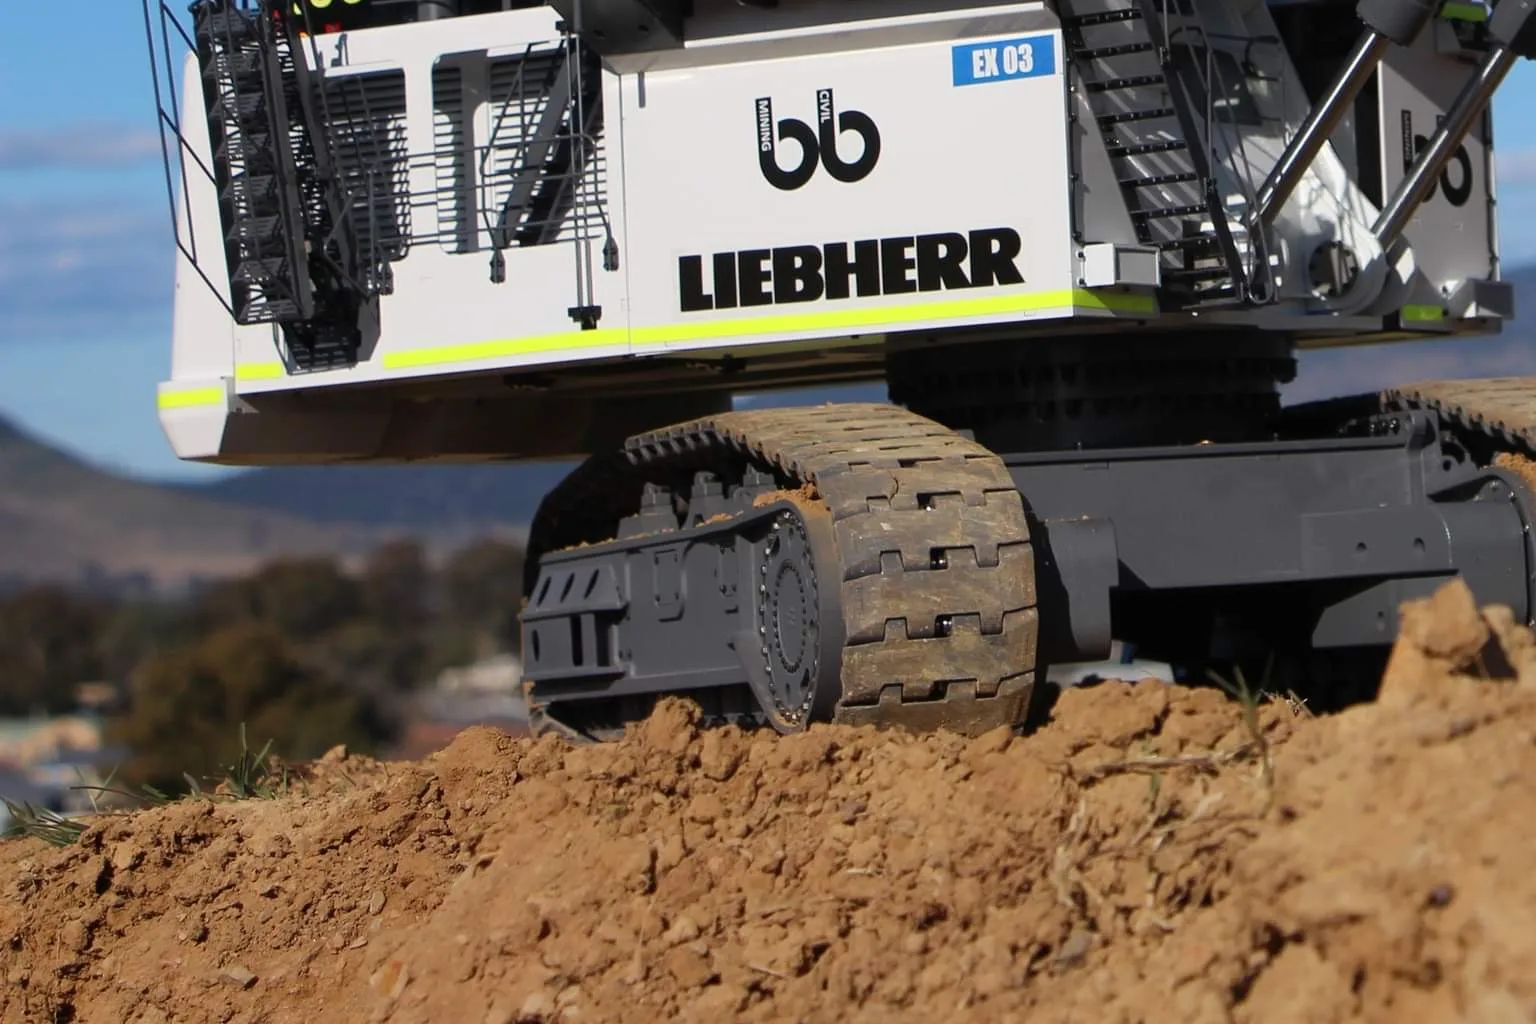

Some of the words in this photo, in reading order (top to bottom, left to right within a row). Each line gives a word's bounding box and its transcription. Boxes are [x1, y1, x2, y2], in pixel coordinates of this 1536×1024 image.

[972, 47, 1000, 79] EX
[1003, 43, 1034, 75] 03
[758, 99, 772, 152] MINING
[819, 90, 832, 124] CIVIL
[679, 227, 1025, 312] LIEBHERR
